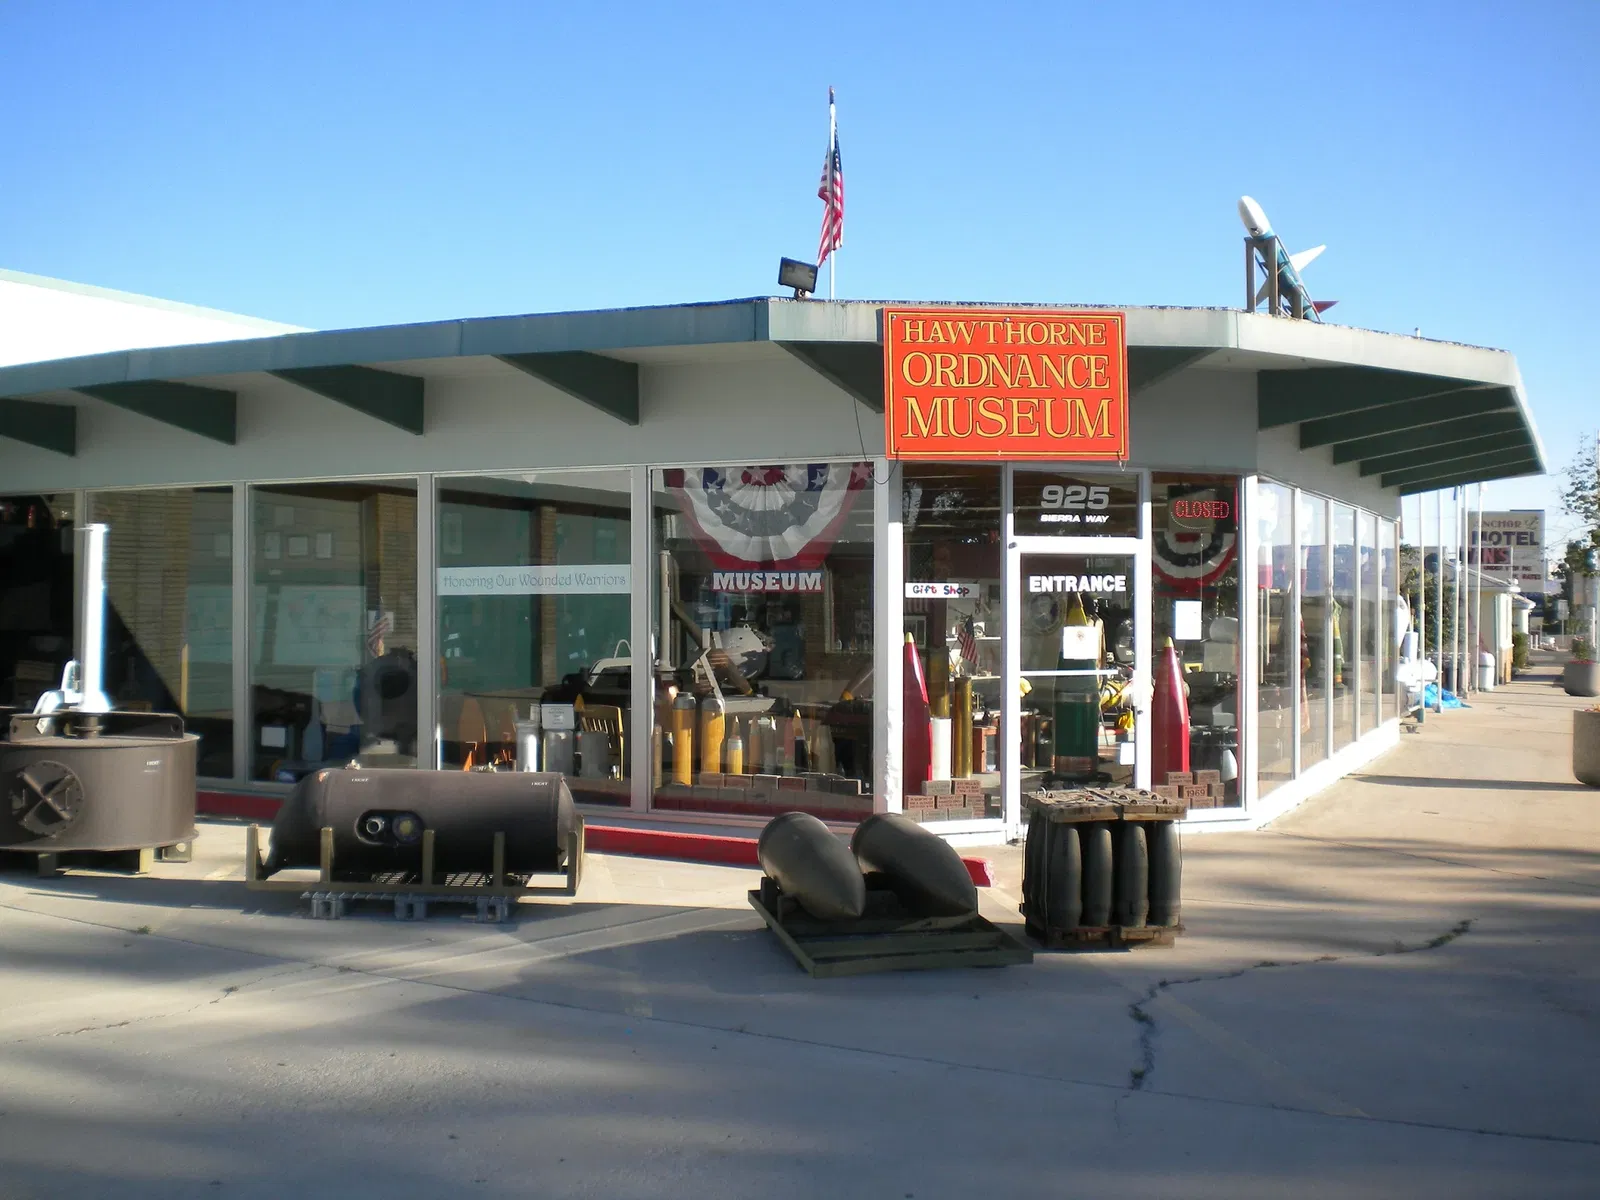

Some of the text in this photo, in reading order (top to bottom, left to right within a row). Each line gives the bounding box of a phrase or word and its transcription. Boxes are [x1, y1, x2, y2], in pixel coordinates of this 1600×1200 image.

[902, 319, 1106, 345] HAWTHORNE
[901, 351, 1110, 389] ORDNANCE
[901, 396, 1115, 439] MUSEUM
[1041, 485, 1110, 509] 925
[1175, 500, 1229, 518] CLOSED
[1040, 514, 1109, 523] SIERRA WAY
[1476, 520, 1521, 529] NCHOR
[443, 573, 626, 589] Honoring Our Wounded Warriors
[712, 572, 822, 590] MUSEUM
[1029, 575, 1127, 592] ENTRANCE
[912, 585, 970, 597] Gift Shop
[1186, 789, 1206, 797] 1969
